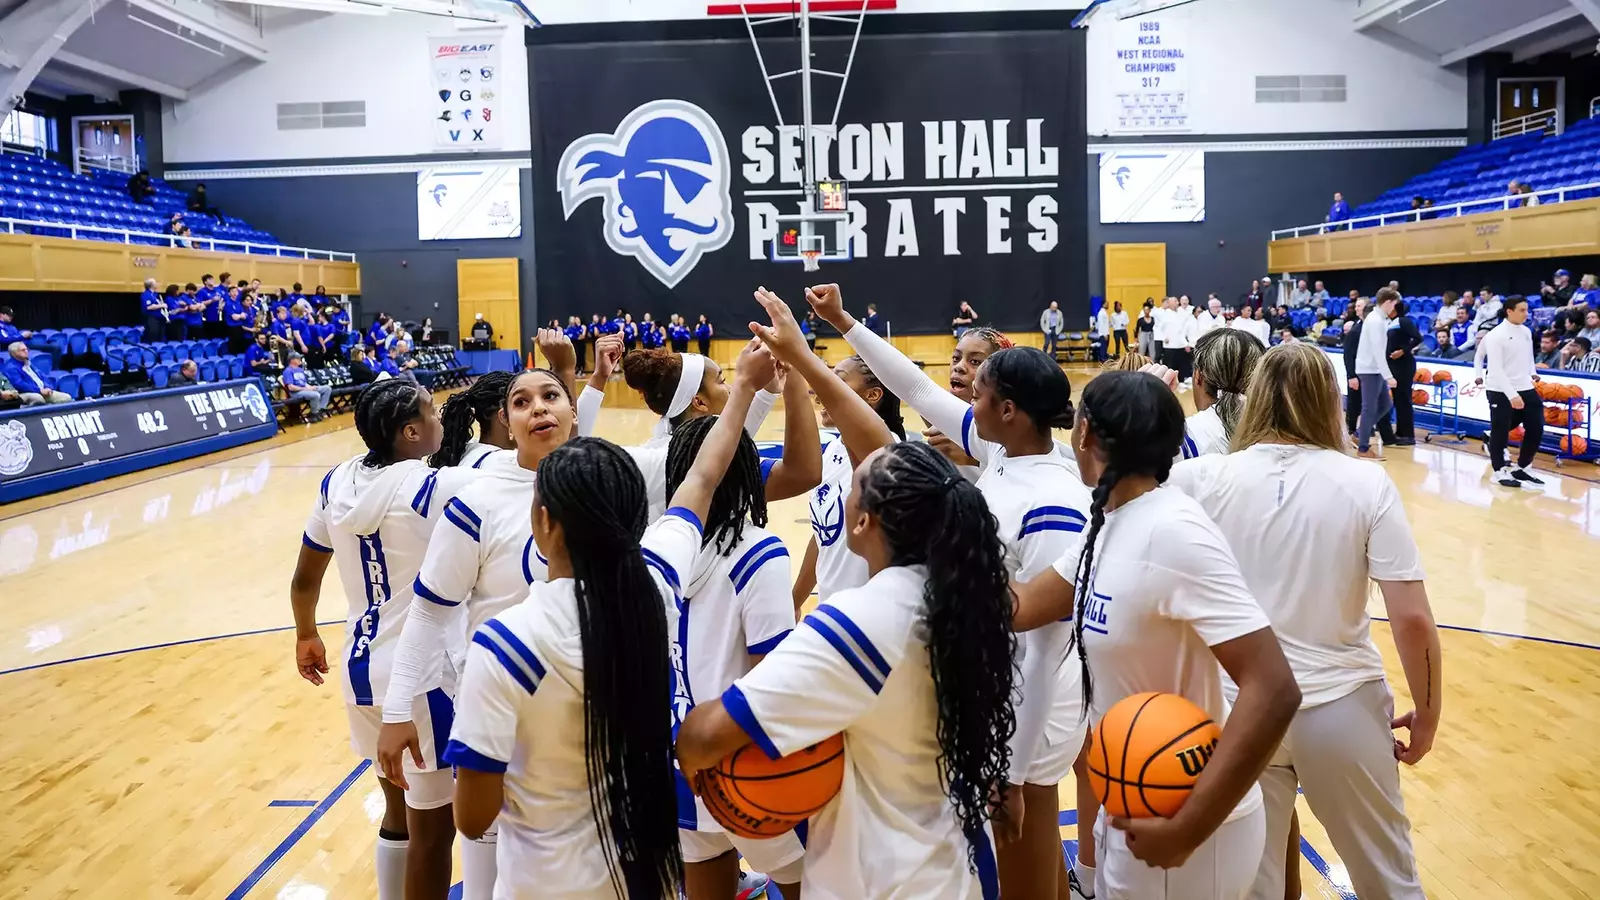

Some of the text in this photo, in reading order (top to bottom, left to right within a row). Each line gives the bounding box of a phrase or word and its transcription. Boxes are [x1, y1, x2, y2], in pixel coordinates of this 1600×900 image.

[1140, 22, 1160, 31] 1989
[1138, 35, 1161, 45] NCAA
[1117, 48, 1184, 59] WEST REGIONAL
[1125, 62, 1176, 73] CHAMPIONS
[460, 89, 472, 102] G
[472, 128, 484, 141] X
[741, 118, 1059, 184] SETON HALL
[183, 388, 243, 416] THE HALL
[41, 410, 105, 442] BRYANT
[77, 437, 90, 456] 0
